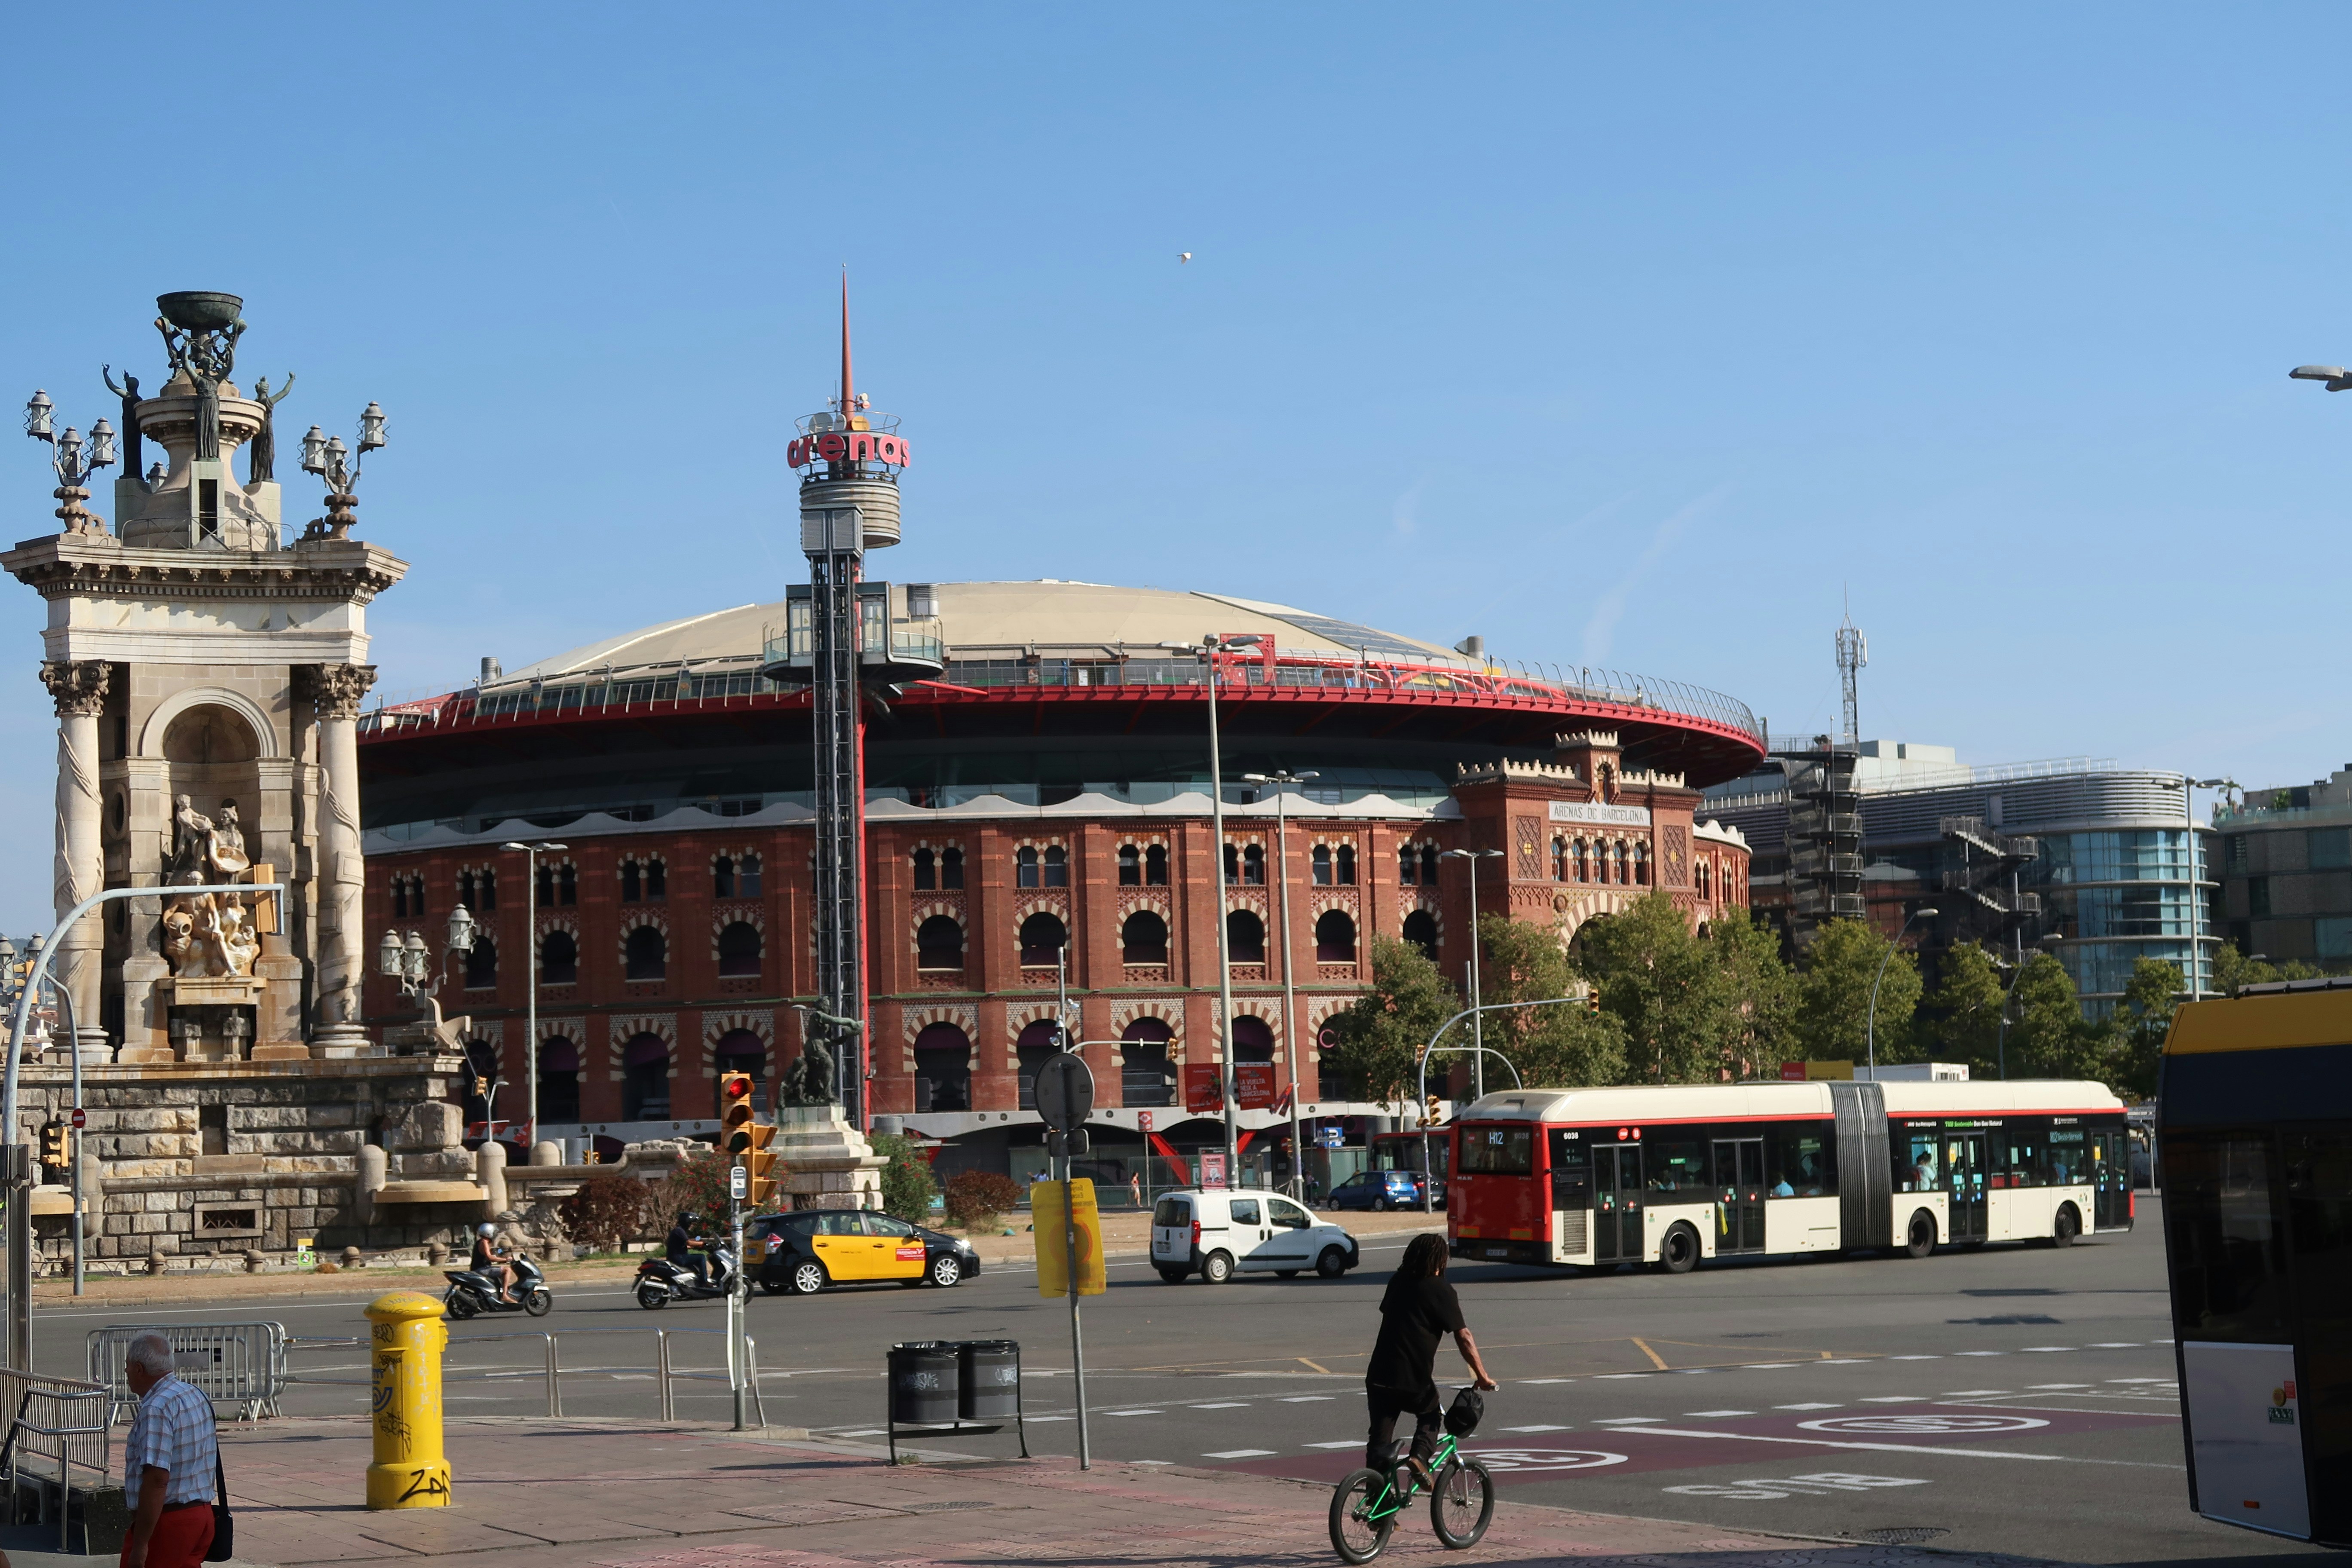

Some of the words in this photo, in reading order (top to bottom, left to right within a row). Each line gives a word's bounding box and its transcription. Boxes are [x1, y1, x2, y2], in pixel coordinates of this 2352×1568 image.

[787, 433, 911, 468] arenas
[1555, 805, 1583, 818] ARENAS
[1588, 807, 1597, 820] DE
[1602, 808, 1644, 823] BARCELONA
[1489, 1132, 1504, 1145] H12
[1563, 1132, 1579, 1140] 6038
[1661, 1472, 1935, 1500] BUS
